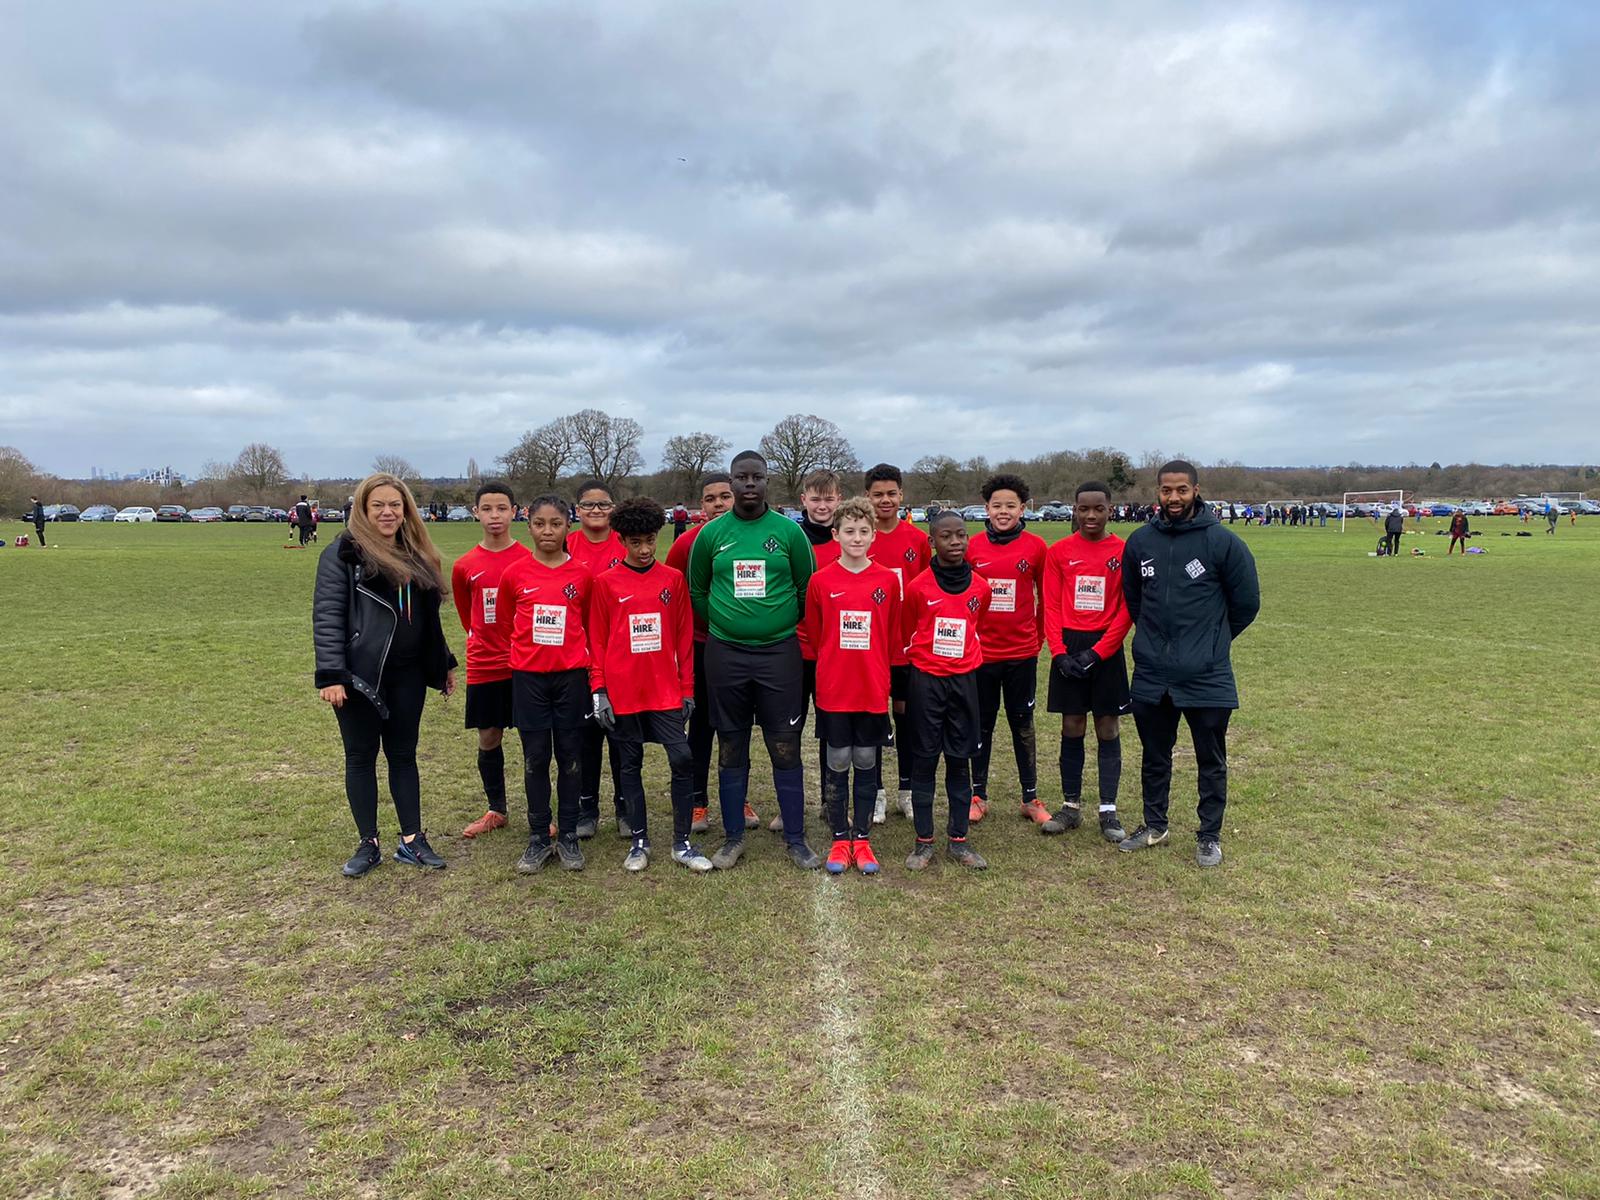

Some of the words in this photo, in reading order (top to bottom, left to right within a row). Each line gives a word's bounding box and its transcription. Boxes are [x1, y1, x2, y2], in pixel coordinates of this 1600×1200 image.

[737, 570, 757, 578] HIRE
[1141, 566, 1155, 577] DB
[1078, 585, 1097, 593] HIRE
[536, 616, 556, 625] HIRE
[633, 624, 653, 633] HIRE
[843, 621, 862, 630] HIRE
[937, 628, 957, 637] HIRE
